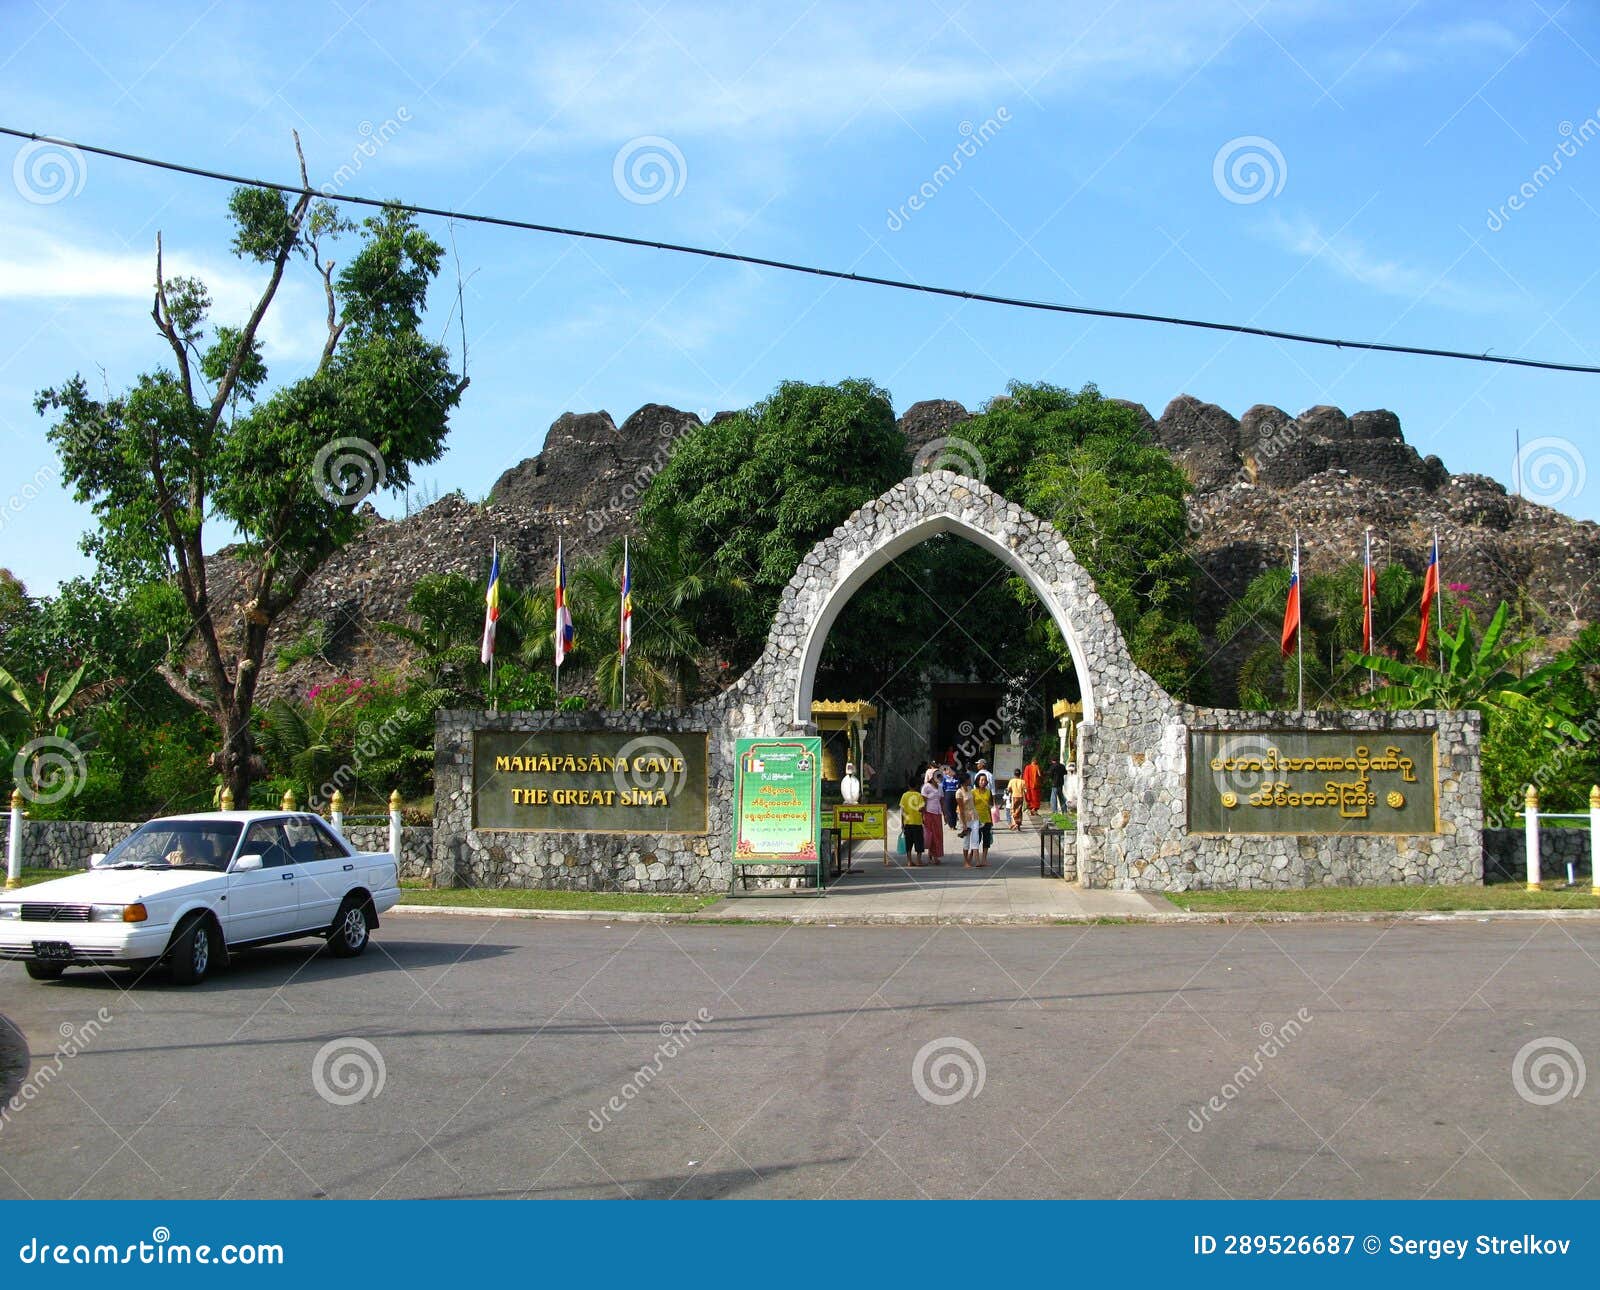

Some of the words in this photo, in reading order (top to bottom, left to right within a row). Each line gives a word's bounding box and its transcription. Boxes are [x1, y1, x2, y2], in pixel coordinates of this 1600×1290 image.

[633, 757, 684, 772] CAVE
[512, 789, 548, 805] THE
[552, 789, 615, 806] GREAT
[620, 787, 668, 806] SĪMĀ
